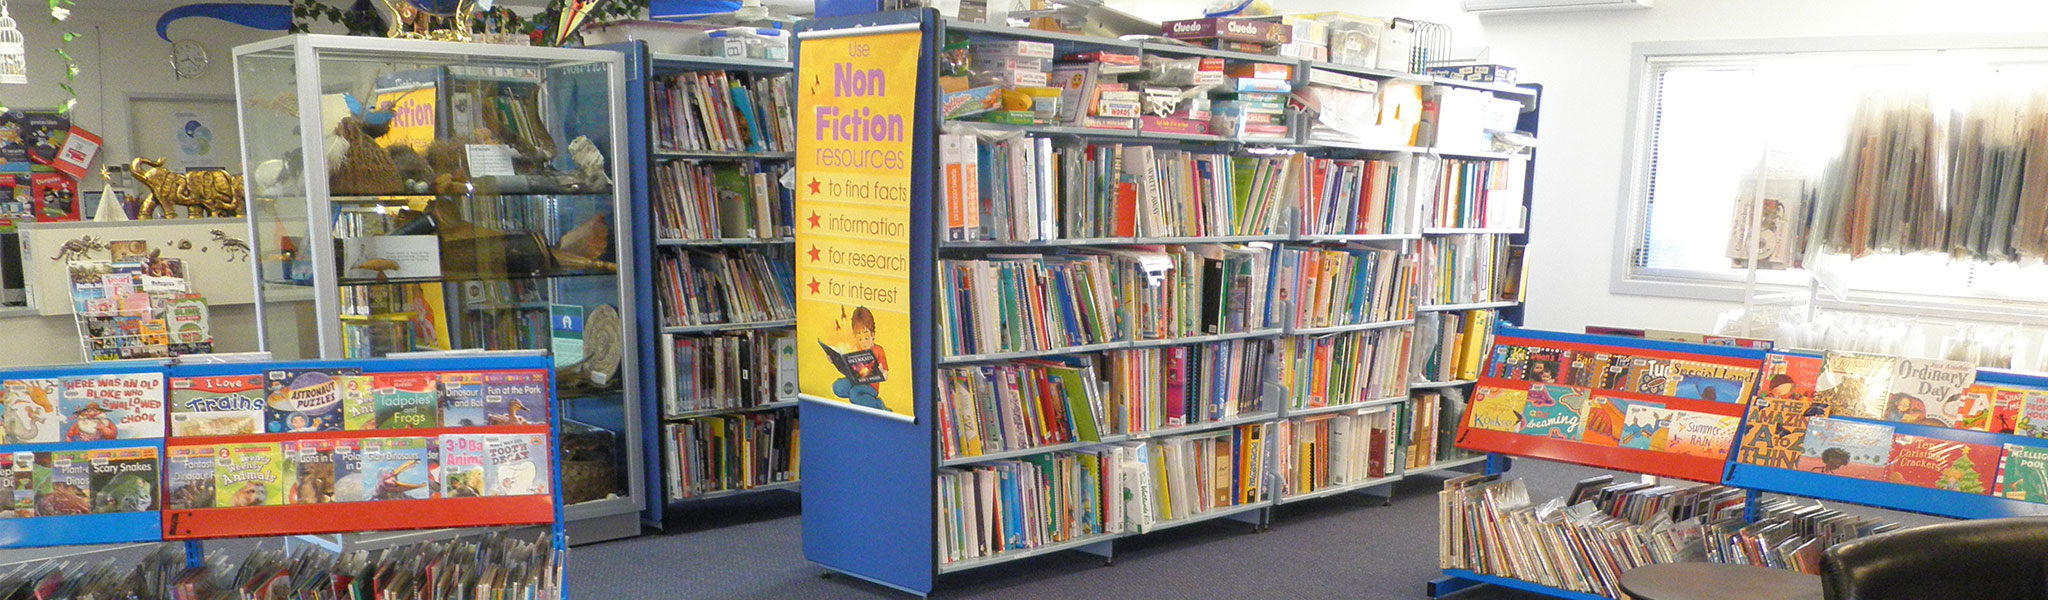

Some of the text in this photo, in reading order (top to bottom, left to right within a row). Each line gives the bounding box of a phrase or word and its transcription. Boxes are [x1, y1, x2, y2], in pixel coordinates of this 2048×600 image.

[1173, 21, 1201, 33] Cluedo
[1227, 21, 1257, 35] Cluedo
[848, 40, 870, 58] Use
[834, 62, 886, 98] Non
[815, 106, 904, 143] Fiction
[815, 147, 904, 170] resources
[828, 178, 907, 202] to find facts
[828, 213, 905, 238] information
[828, 246, 907, 272] for research
[828, 278, 898, 304] for interest
[1673, 363, 1754, 383] Special Land
[1899, 359, 1970, 388] Ordinary
[61, 378, 159, 390] THERE WAS AN OLD
[205, 378, 243, 389] I Love
[487, 385, 541, 395] Fun at the Park
[86, 389, 144, 399] BLOKE WHO
[290, 382, 336, 400] ASTRONAUT
[446, 388, 479, 398] Dinosaur
[1918, 381, 1950, 401] Day
[102, 397, 162, 410] SWALLOWED
[185, 393, 265, 412] Trains
[297, 392, 336, 408] PUZZLES
[380, 393, 431, 409] Tadpoles
[455, 399, 469, 407] and
[1772, 400, 1804, 413] THE
[120, 413, 156, 424] CHOOK
[394, 412, 426, 424] Frogs
[1527, 412, 1579, 433] dreaming
[1687, 421, 1721, 436] Summer
[1690, 435, 1712, 447] RAIN
[1748, 424, 1774, 449] A
[1774, 436, 1791, 448] TO
[445, 438, 467, 452] 3-D
[489, 443, 528, 457] TOOTH
[300, 454, 328, 463] Lions in
[492, 451, 529, 465] DECAY
[1900, 458, 1941, 471] Crackers
[2020, 459, 2045, 469] POOL
[93, 463, 152, 474] Scary Snakes
[346, 461, 354, 470] in
[174, 472, 208, 482] Dinosaur
[222, 470, 277, 487] Animals
